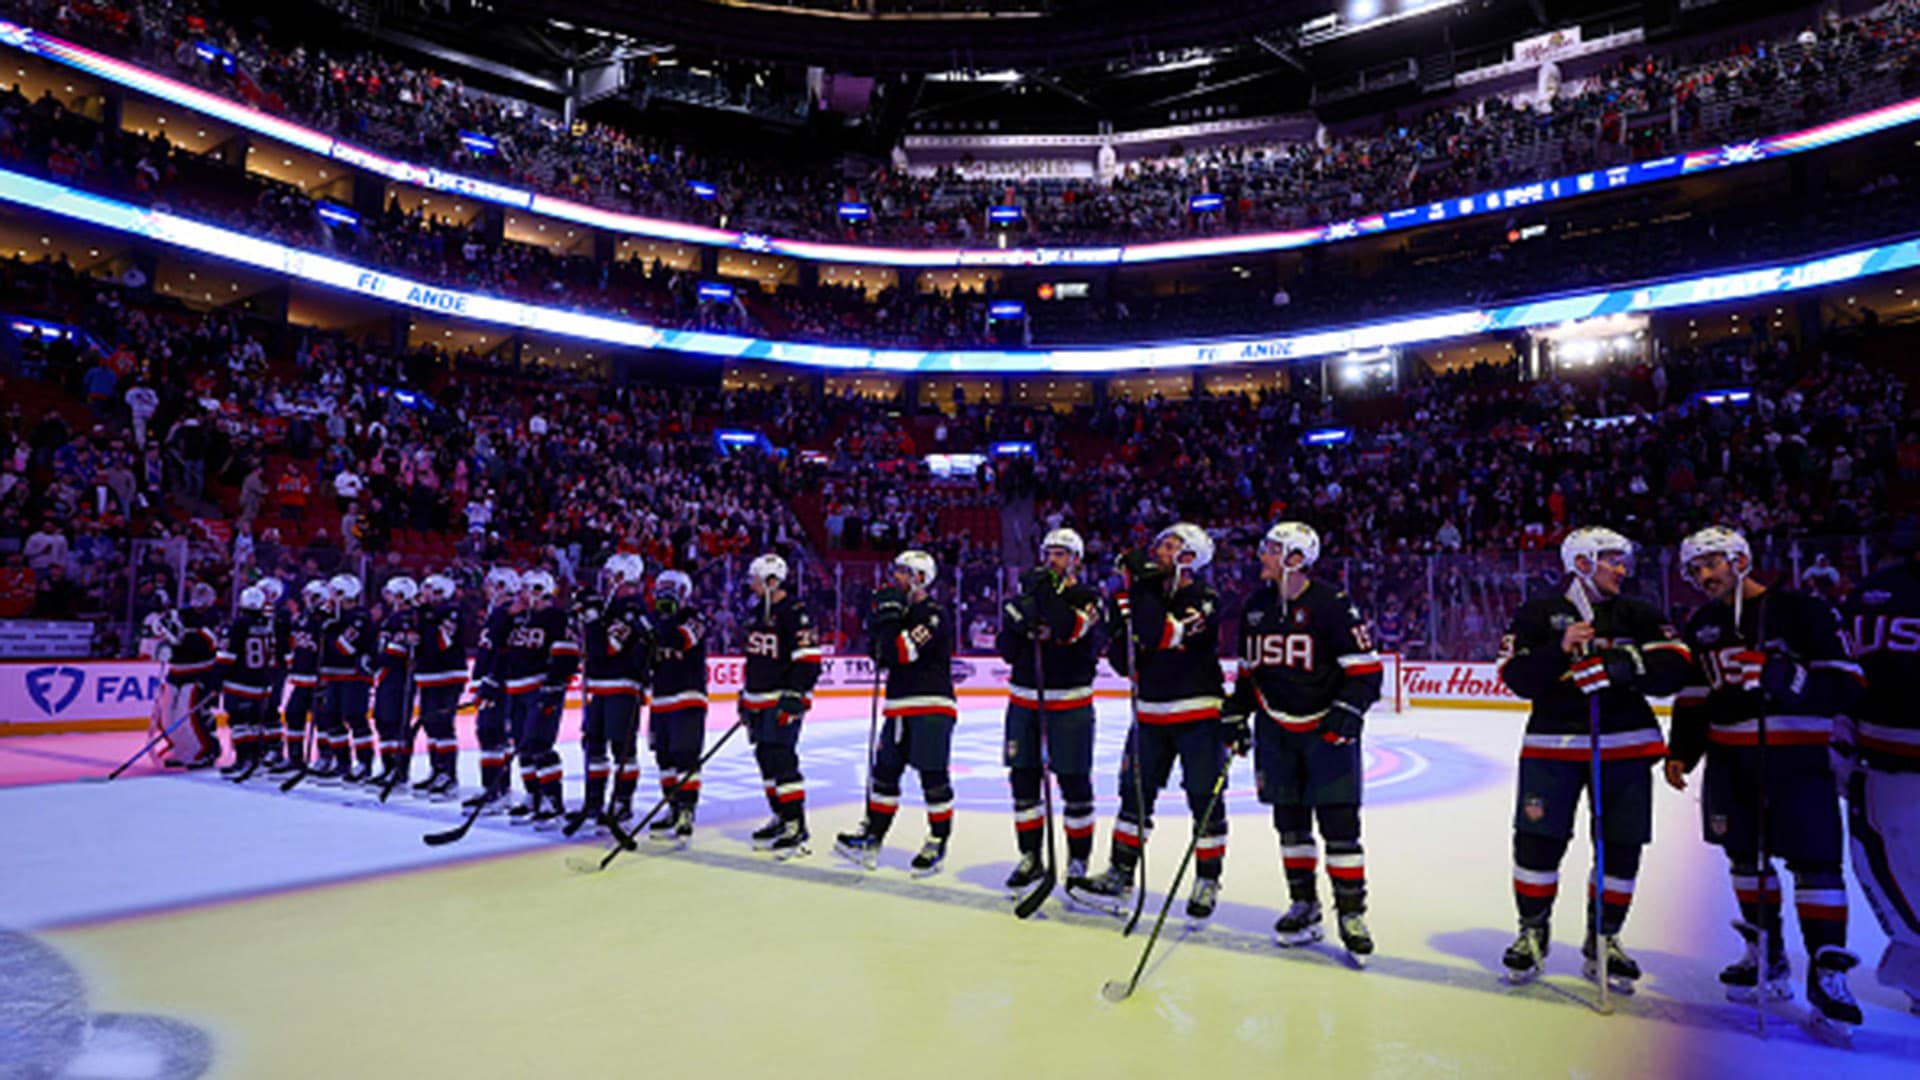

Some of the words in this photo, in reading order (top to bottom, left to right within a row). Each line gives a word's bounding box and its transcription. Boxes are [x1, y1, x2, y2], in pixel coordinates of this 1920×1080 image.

[748, 630, 778, 660] SA
[1247, 632, 1313, 672] USA
[1402, 666, 1441, 694] Tim
